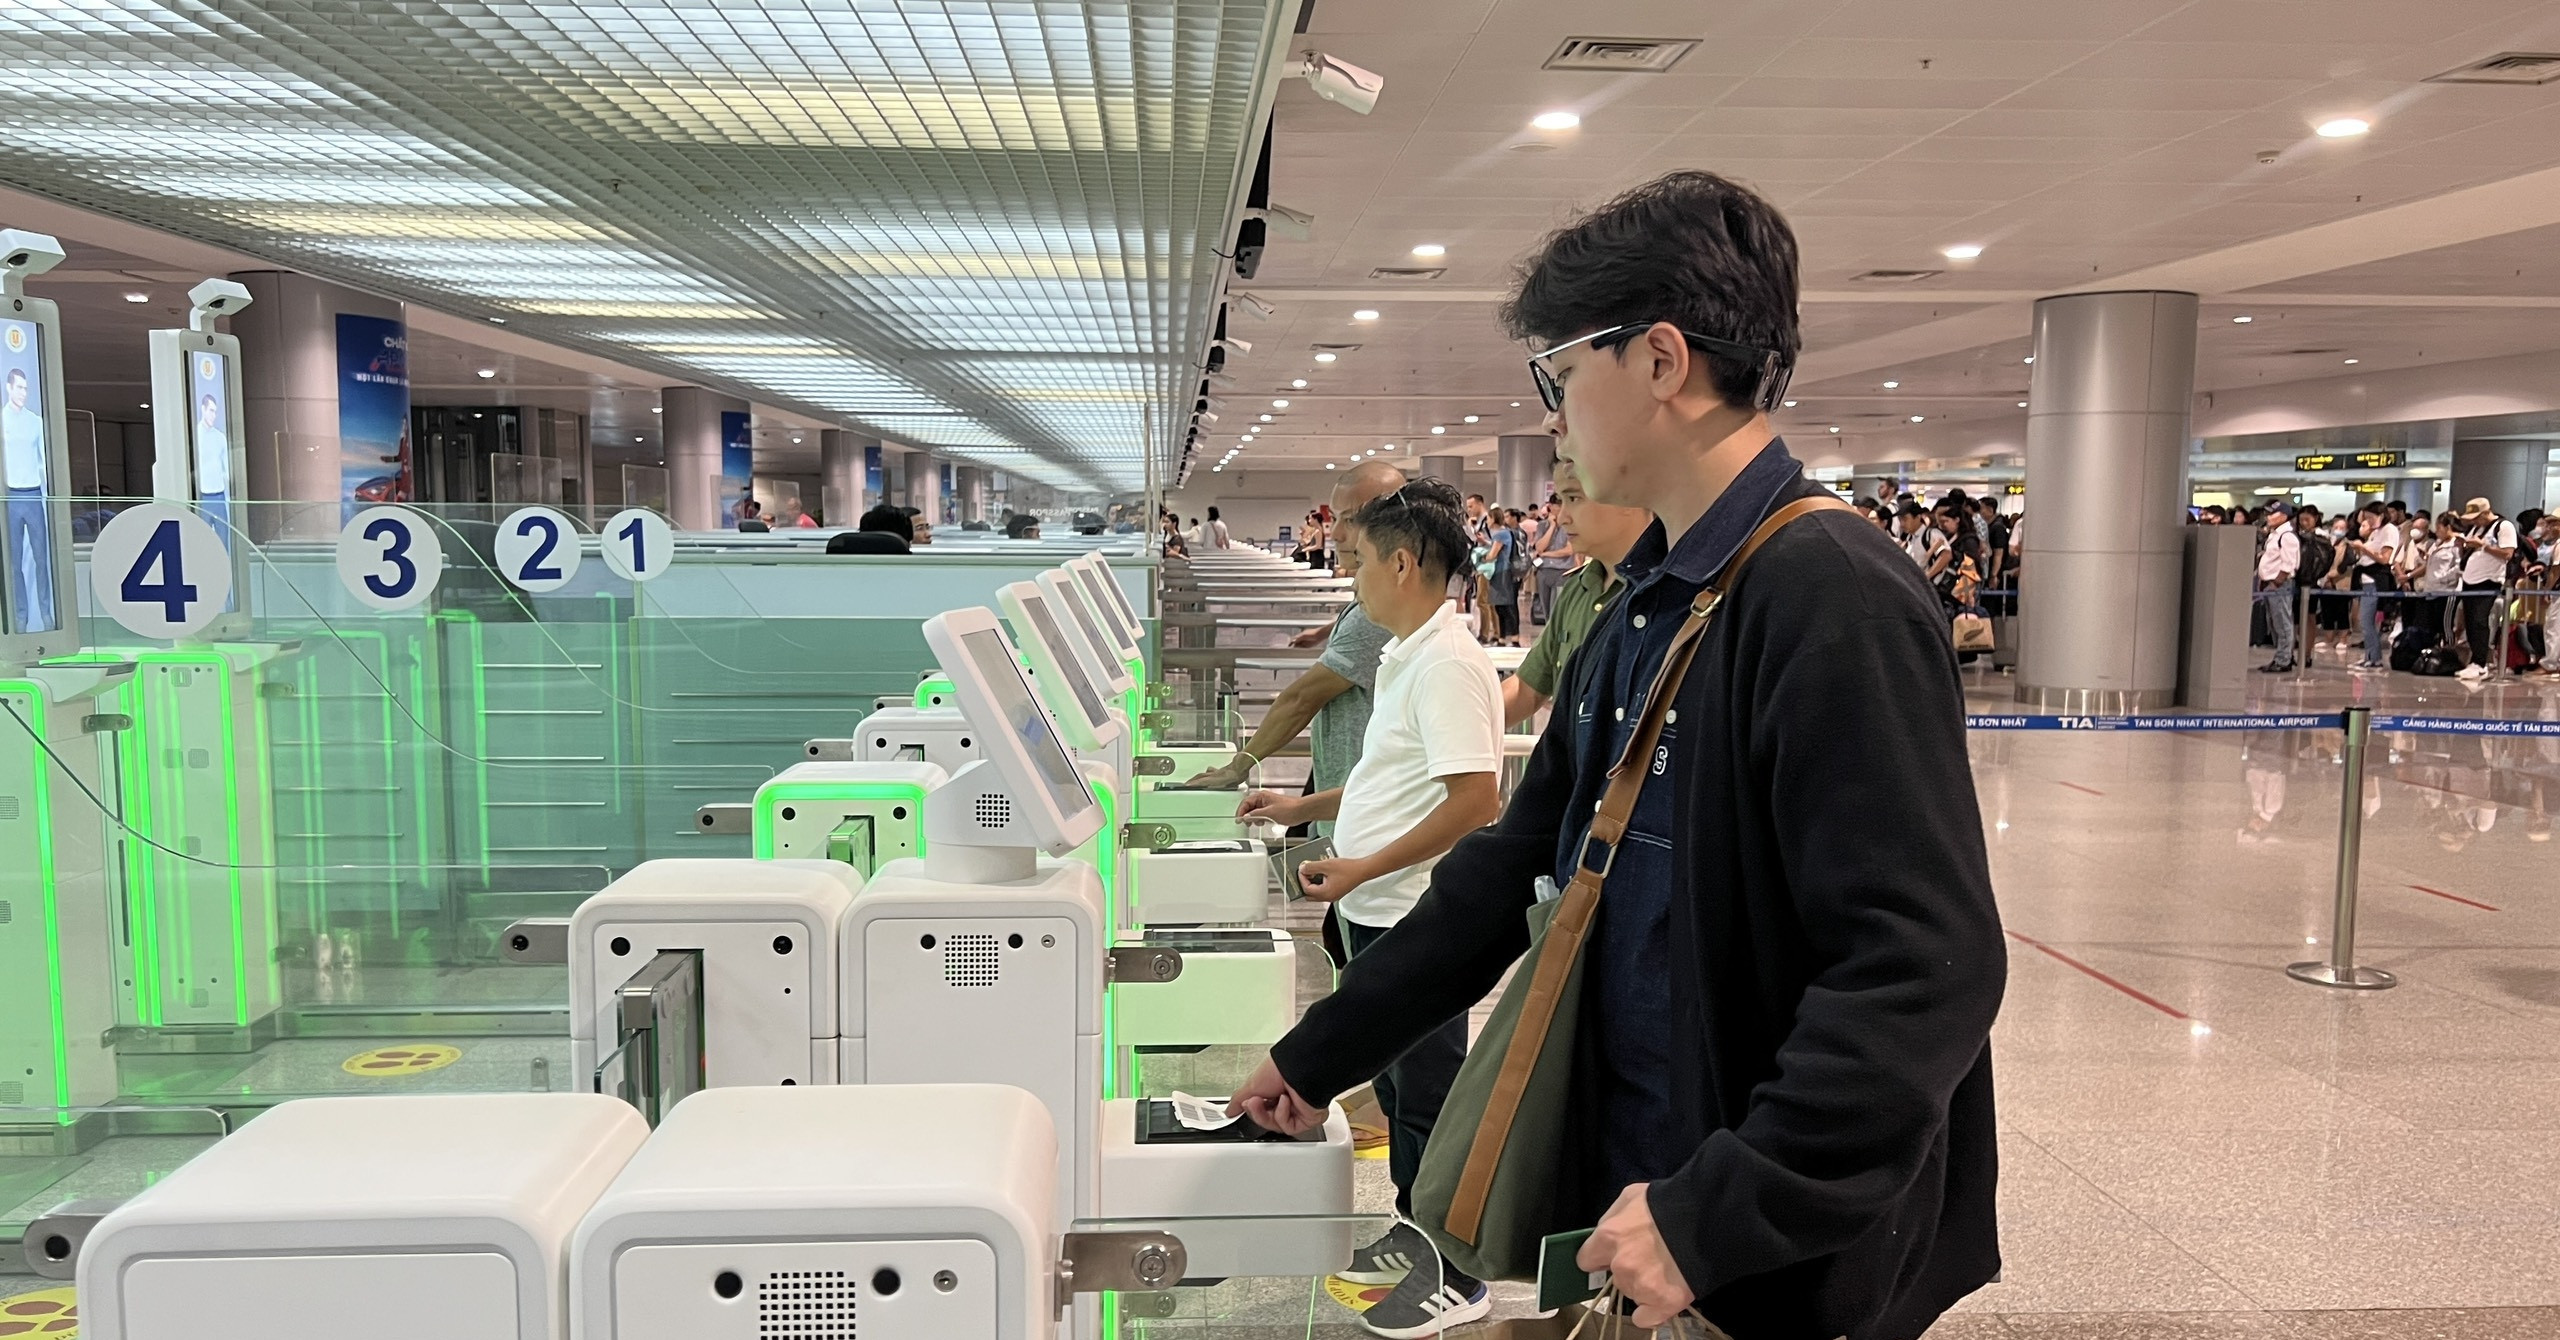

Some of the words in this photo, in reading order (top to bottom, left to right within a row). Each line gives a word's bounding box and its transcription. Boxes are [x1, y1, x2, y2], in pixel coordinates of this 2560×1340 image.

[363, 518, 417, 599] 3
[516, 516, 562, 581] 2
[619, 518, 646, 572] 1
[121, 520, 198, 623] 4
[2058, 717, 2094, 729] TIA
[2134, 718, 2152, 728] TAN
[2154, 718, 2175, 728] SON
[2176, 718, 2201, 728] NHAT
[2202, 718, 2276, 728] INTERNATIONAL
[2278, 717, 2320, 727] AIRPORT
[2428, 718, 2452, 729] HÀNG
[2453, 720, 2484, 731] KHÔNG
[2485, 721, 2510, 732] QUỐC
[2511, 721, 2523, 732] TẾ
[2524, 722, 2541, 732] TÂN
[1652, 745, 1669, 776] S
